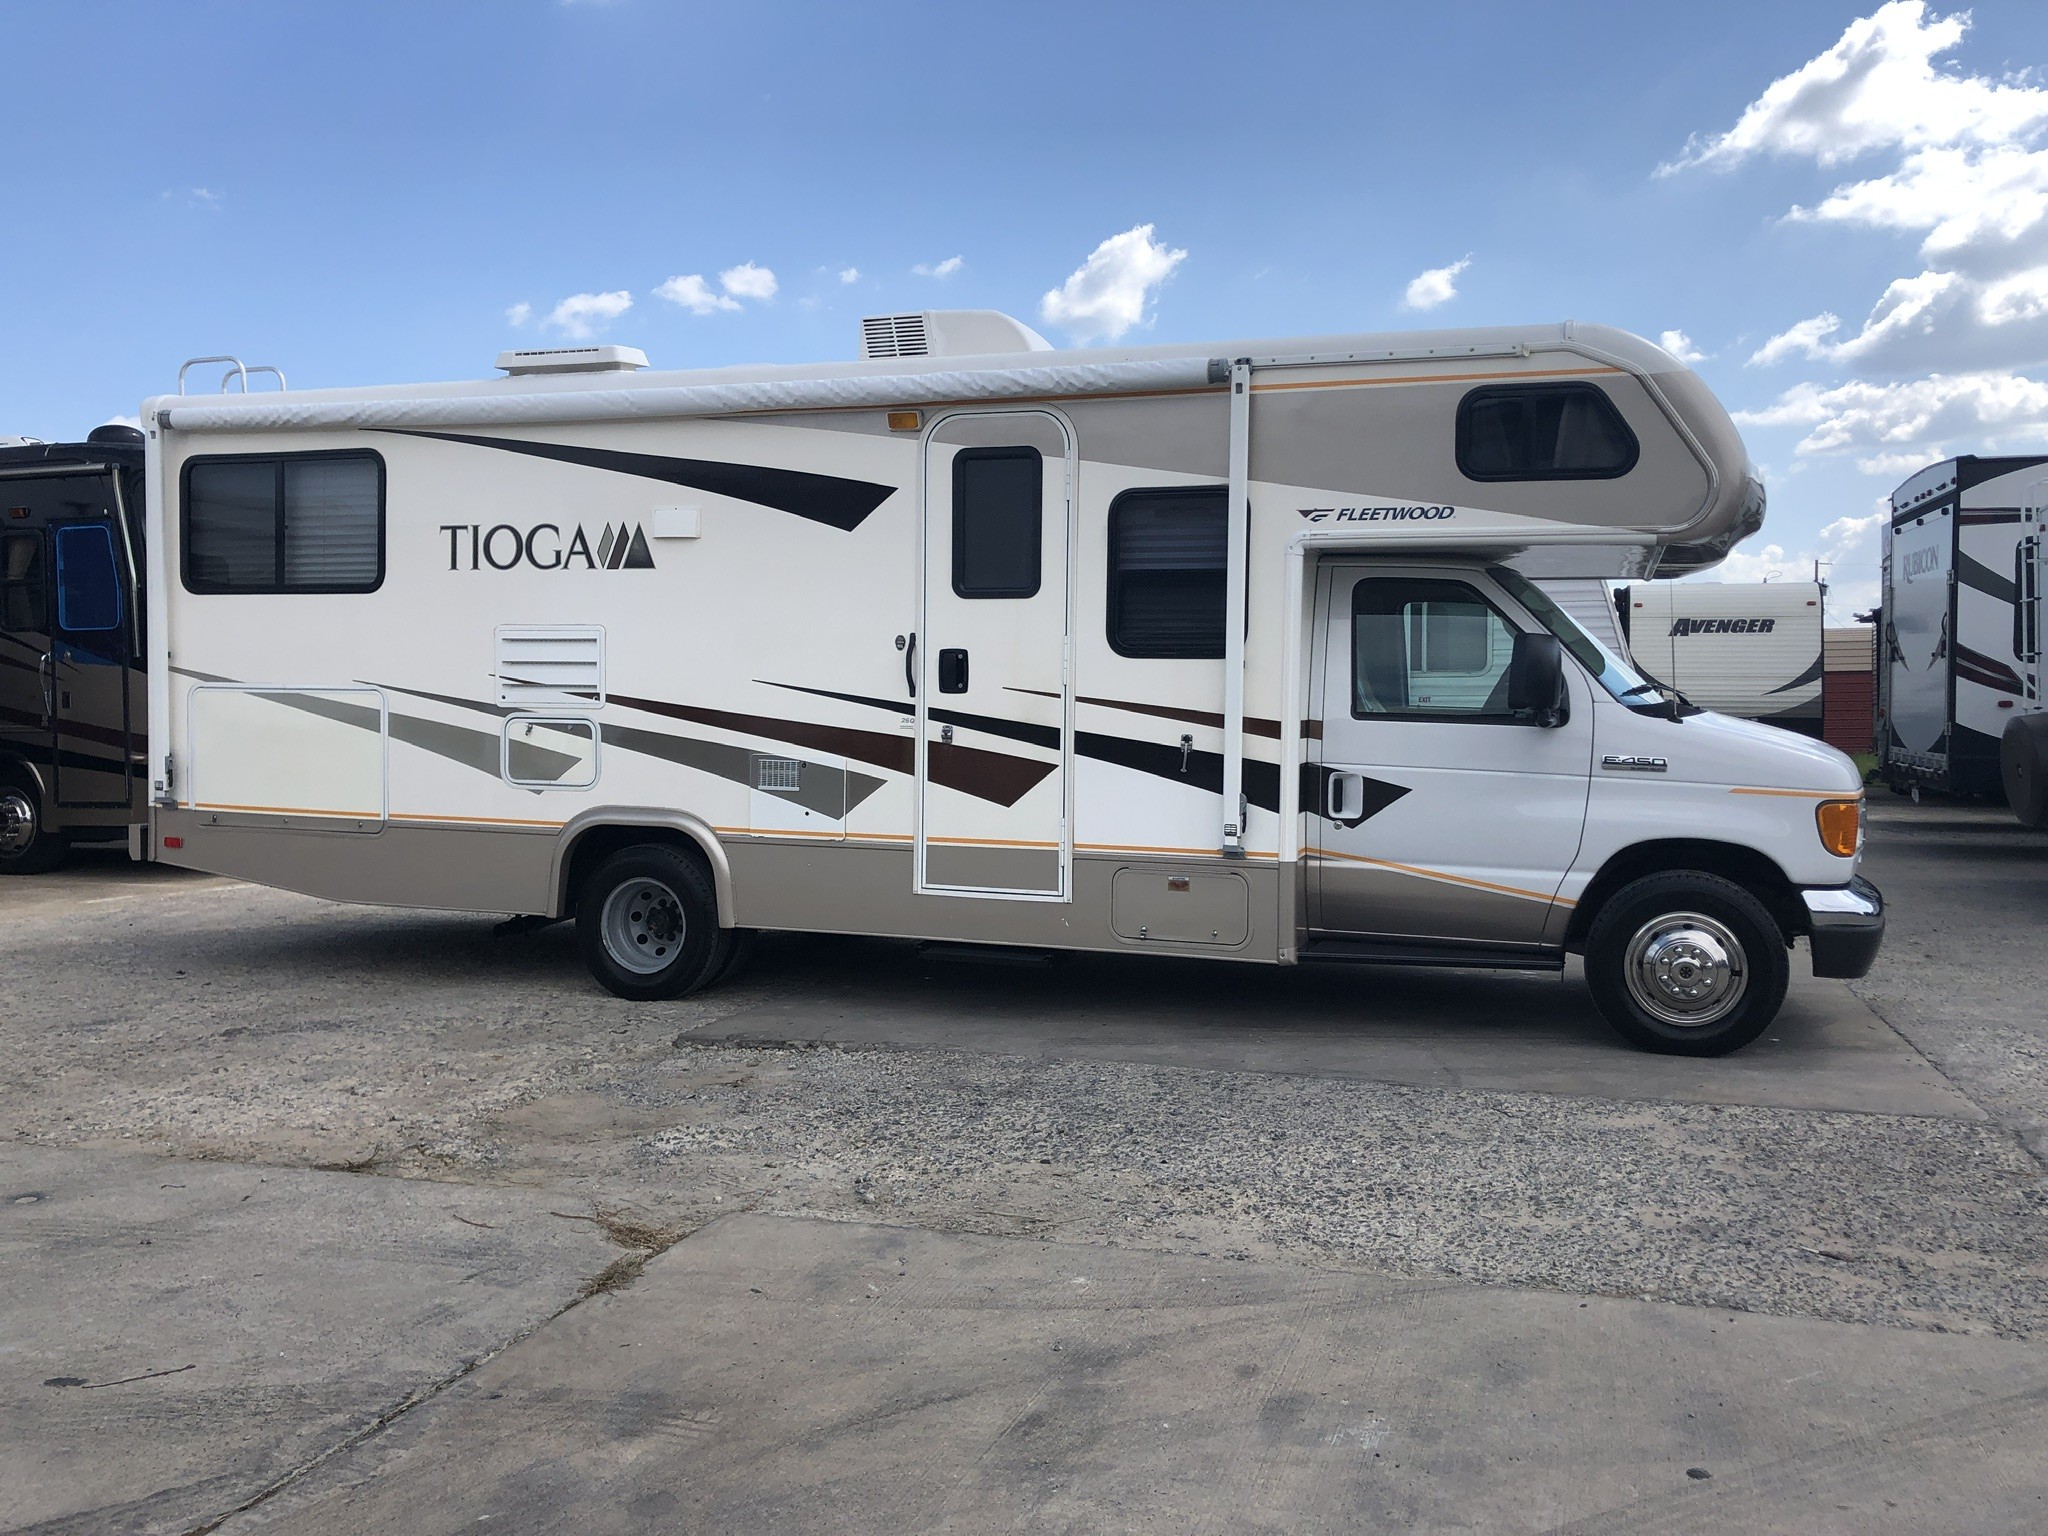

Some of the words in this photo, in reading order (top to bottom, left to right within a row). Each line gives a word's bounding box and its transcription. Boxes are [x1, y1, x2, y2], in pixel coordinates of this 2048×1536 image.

[1336, 506, 1455, 521] FLEETWOOD
[439, 521, 598, 571] TIOGA
[1903, 544, 1939, 584] RUBICON
[1668, 618, 1775, 636] AVENGER
[1603, 755, 1667, 766] E-450
